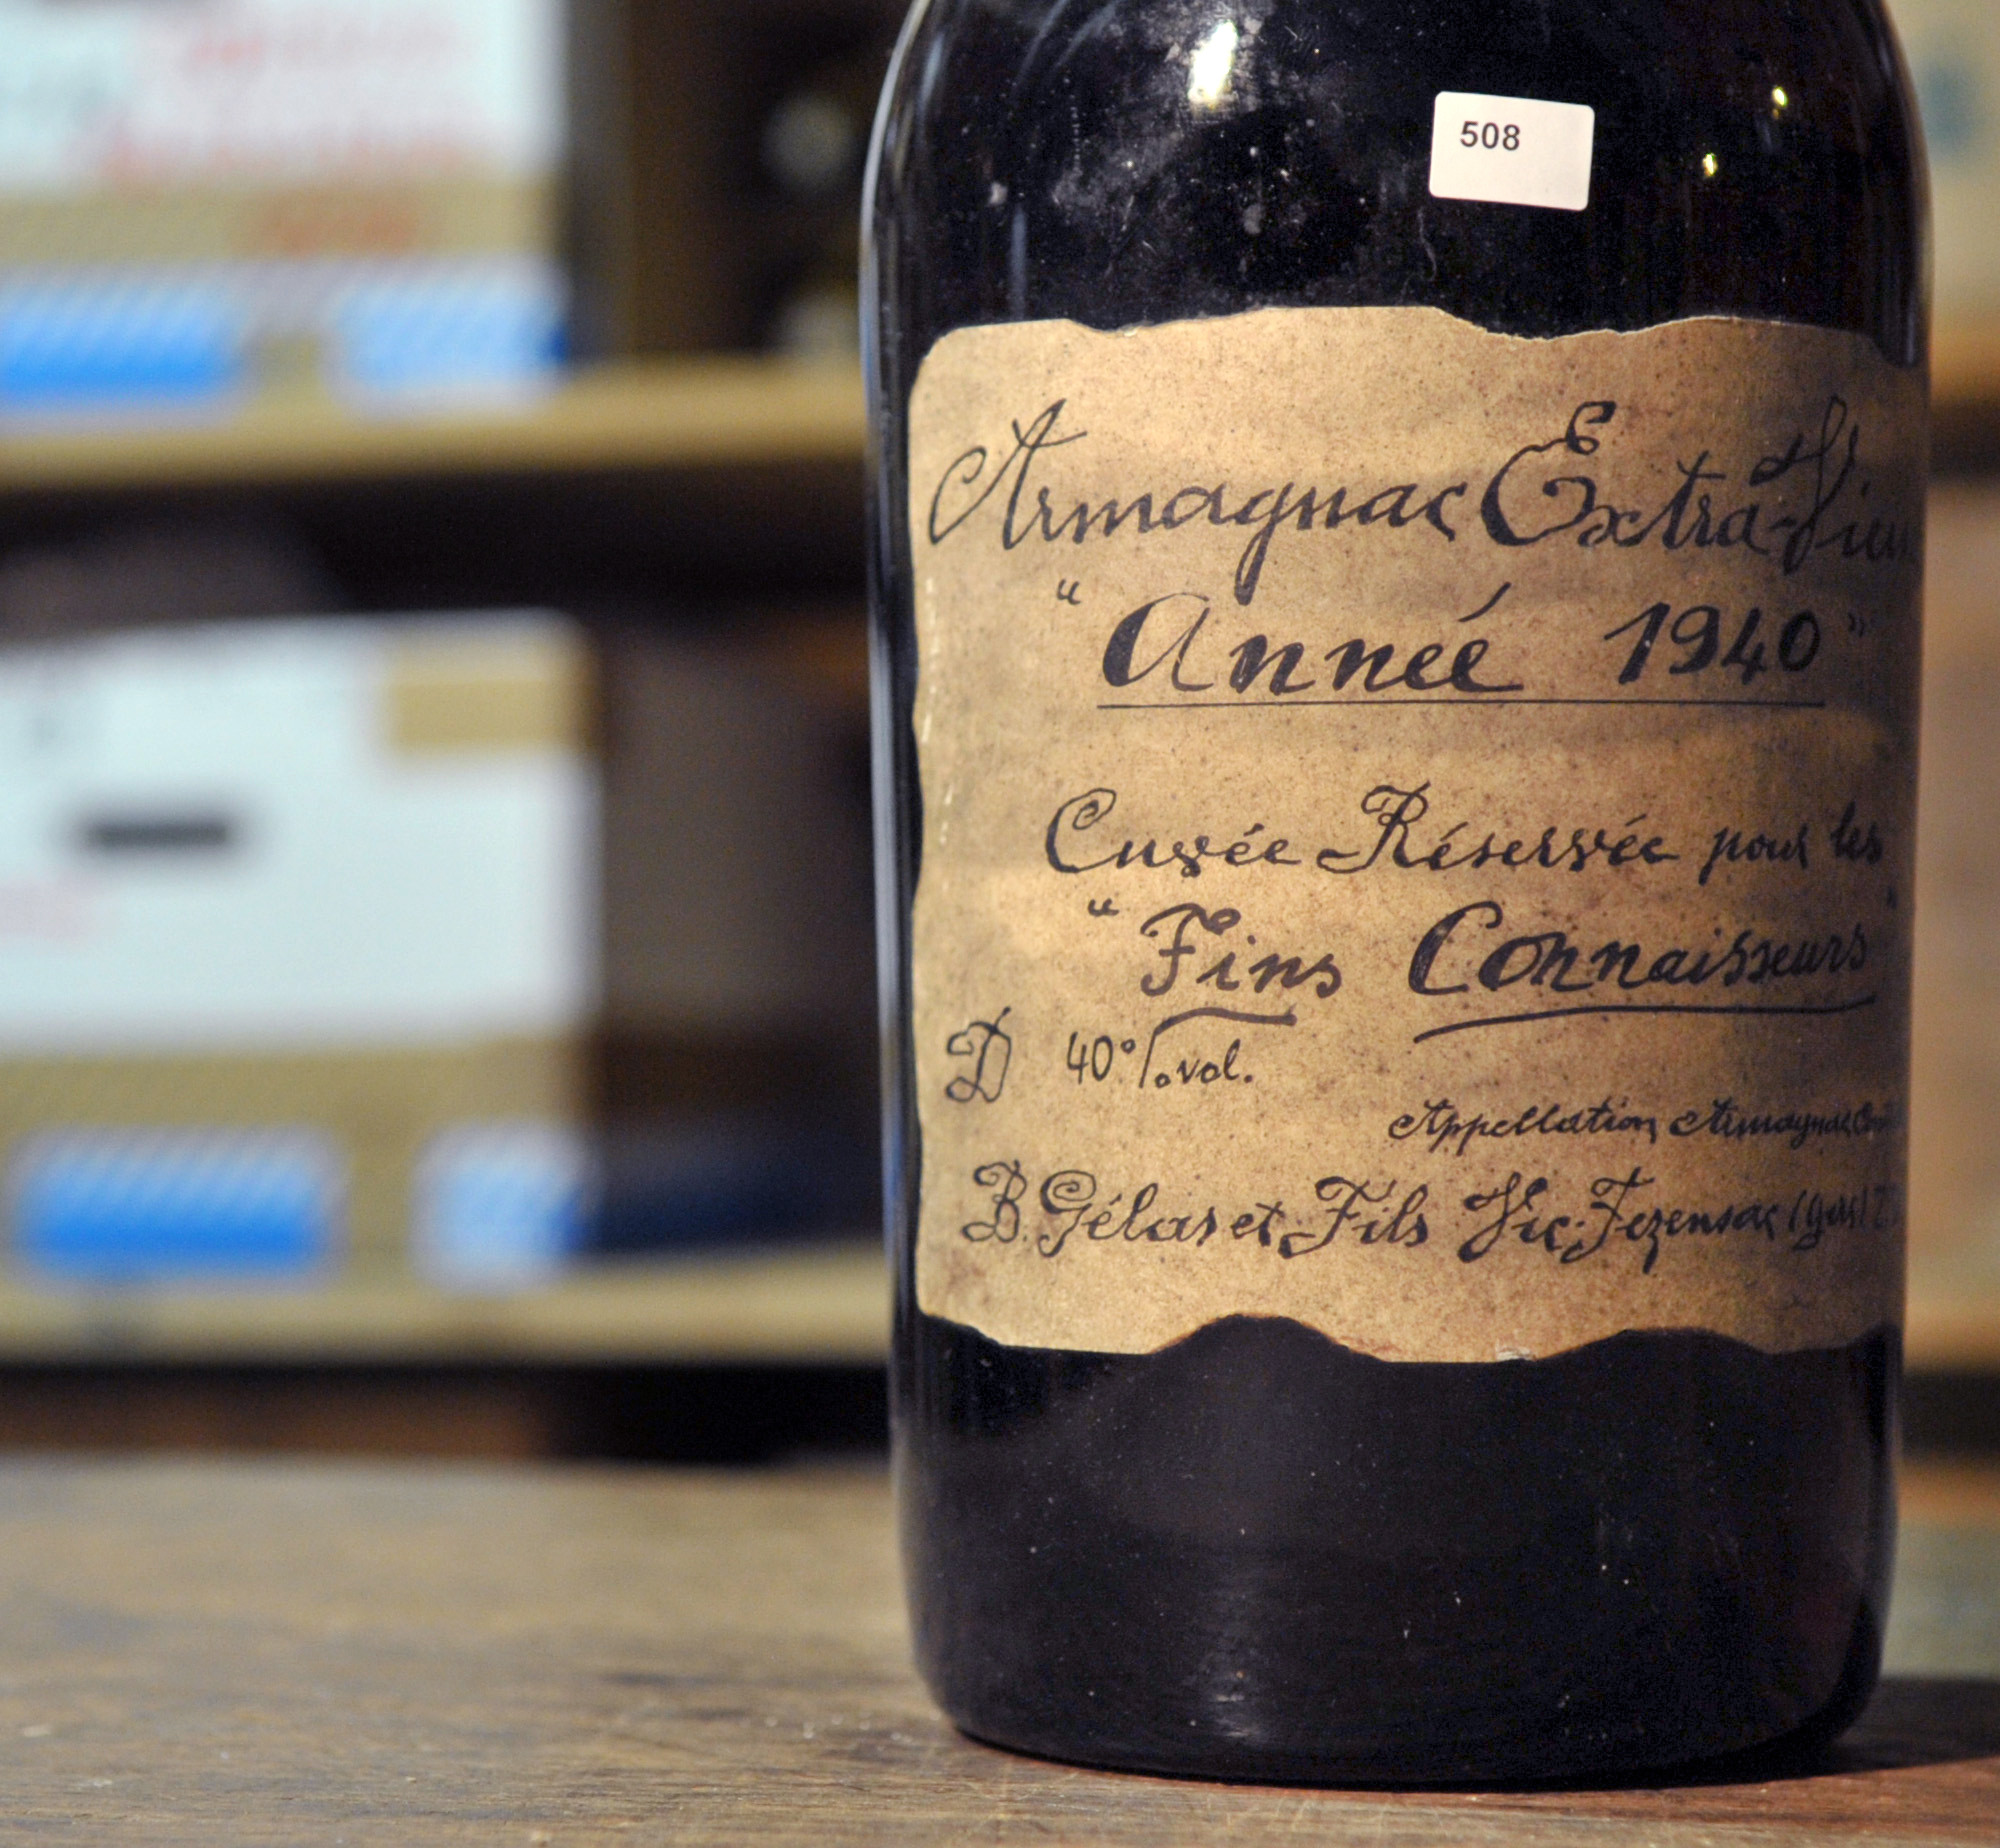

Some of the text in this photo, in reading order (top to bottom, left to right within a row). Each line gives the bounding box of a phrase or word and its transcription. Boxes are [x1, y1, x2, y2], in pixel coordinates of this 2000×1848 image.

[1460, 120, 1520, 151] 508
[927, 398, 1469, 606] Armagnac
[1044, 780, 1884, 886] Cuvée Réservée pour les
[1388, 1098, 1656, 1156] Appellation
[1669, 1096, 1851, 1150] Armagnac
[1037, 1169, 1217, 1258] Gélas
[1230, 1201, 1286, 1247] et
[1277, 1175, 1429, 1259] Fils
